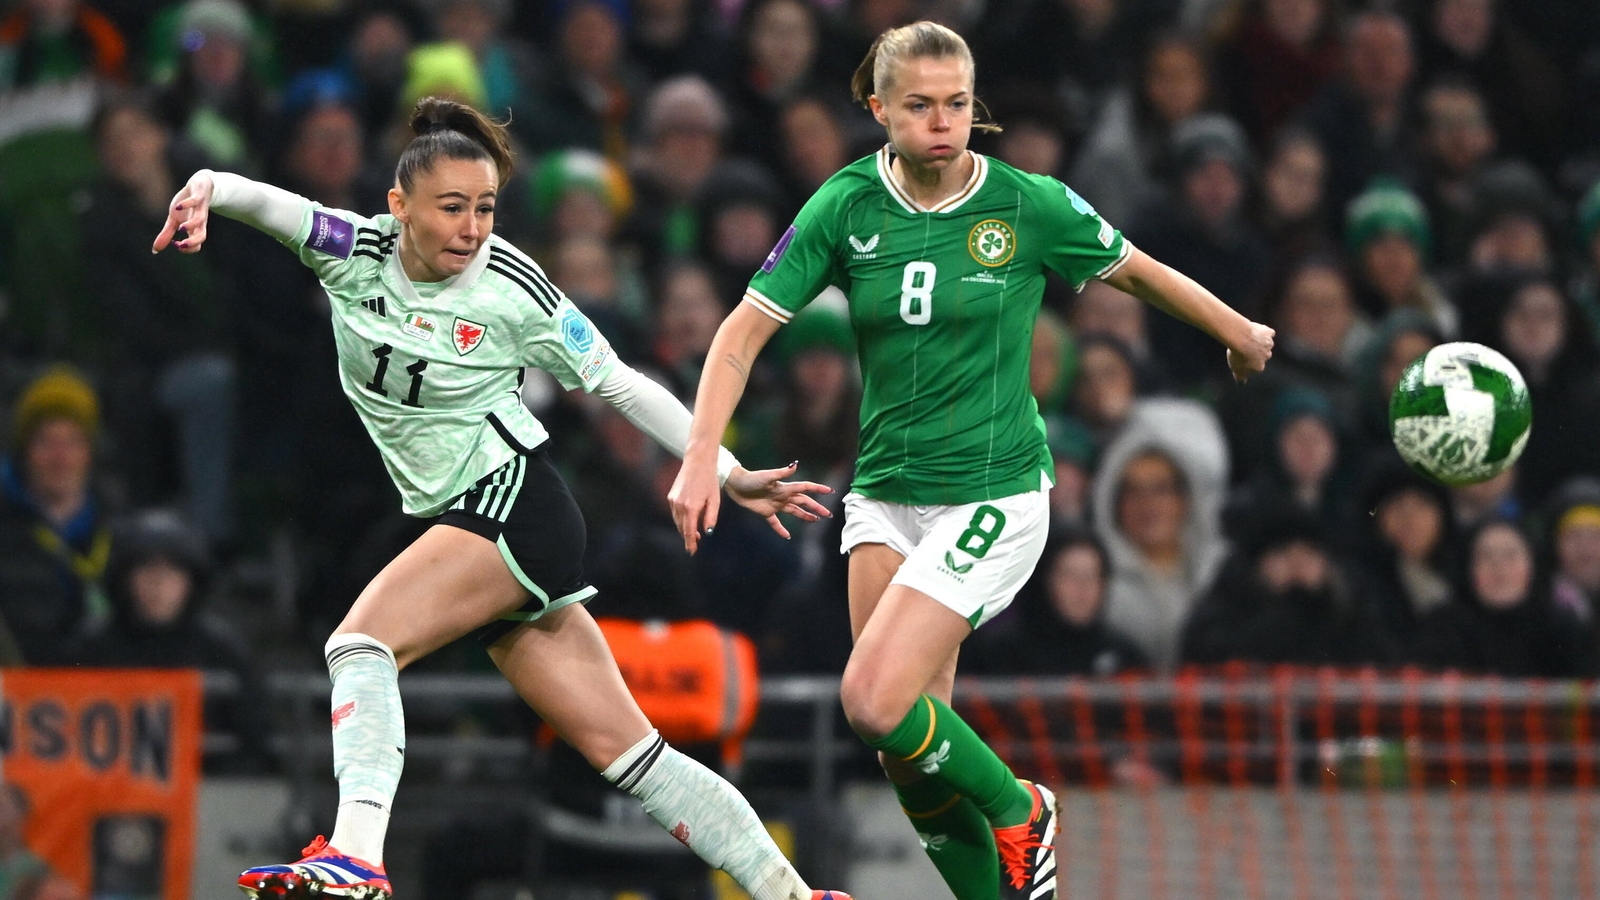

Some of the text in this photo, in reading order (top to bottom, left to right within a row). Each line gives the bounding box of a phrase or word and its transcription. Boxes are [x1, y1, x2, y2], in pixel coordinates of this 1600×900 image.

[973, 223, 1011, 239] IRELAND
[900, 261, 937, 326] 8
[366, 343, 428, 408] 11
[956, 504, 1006, 559] 8
